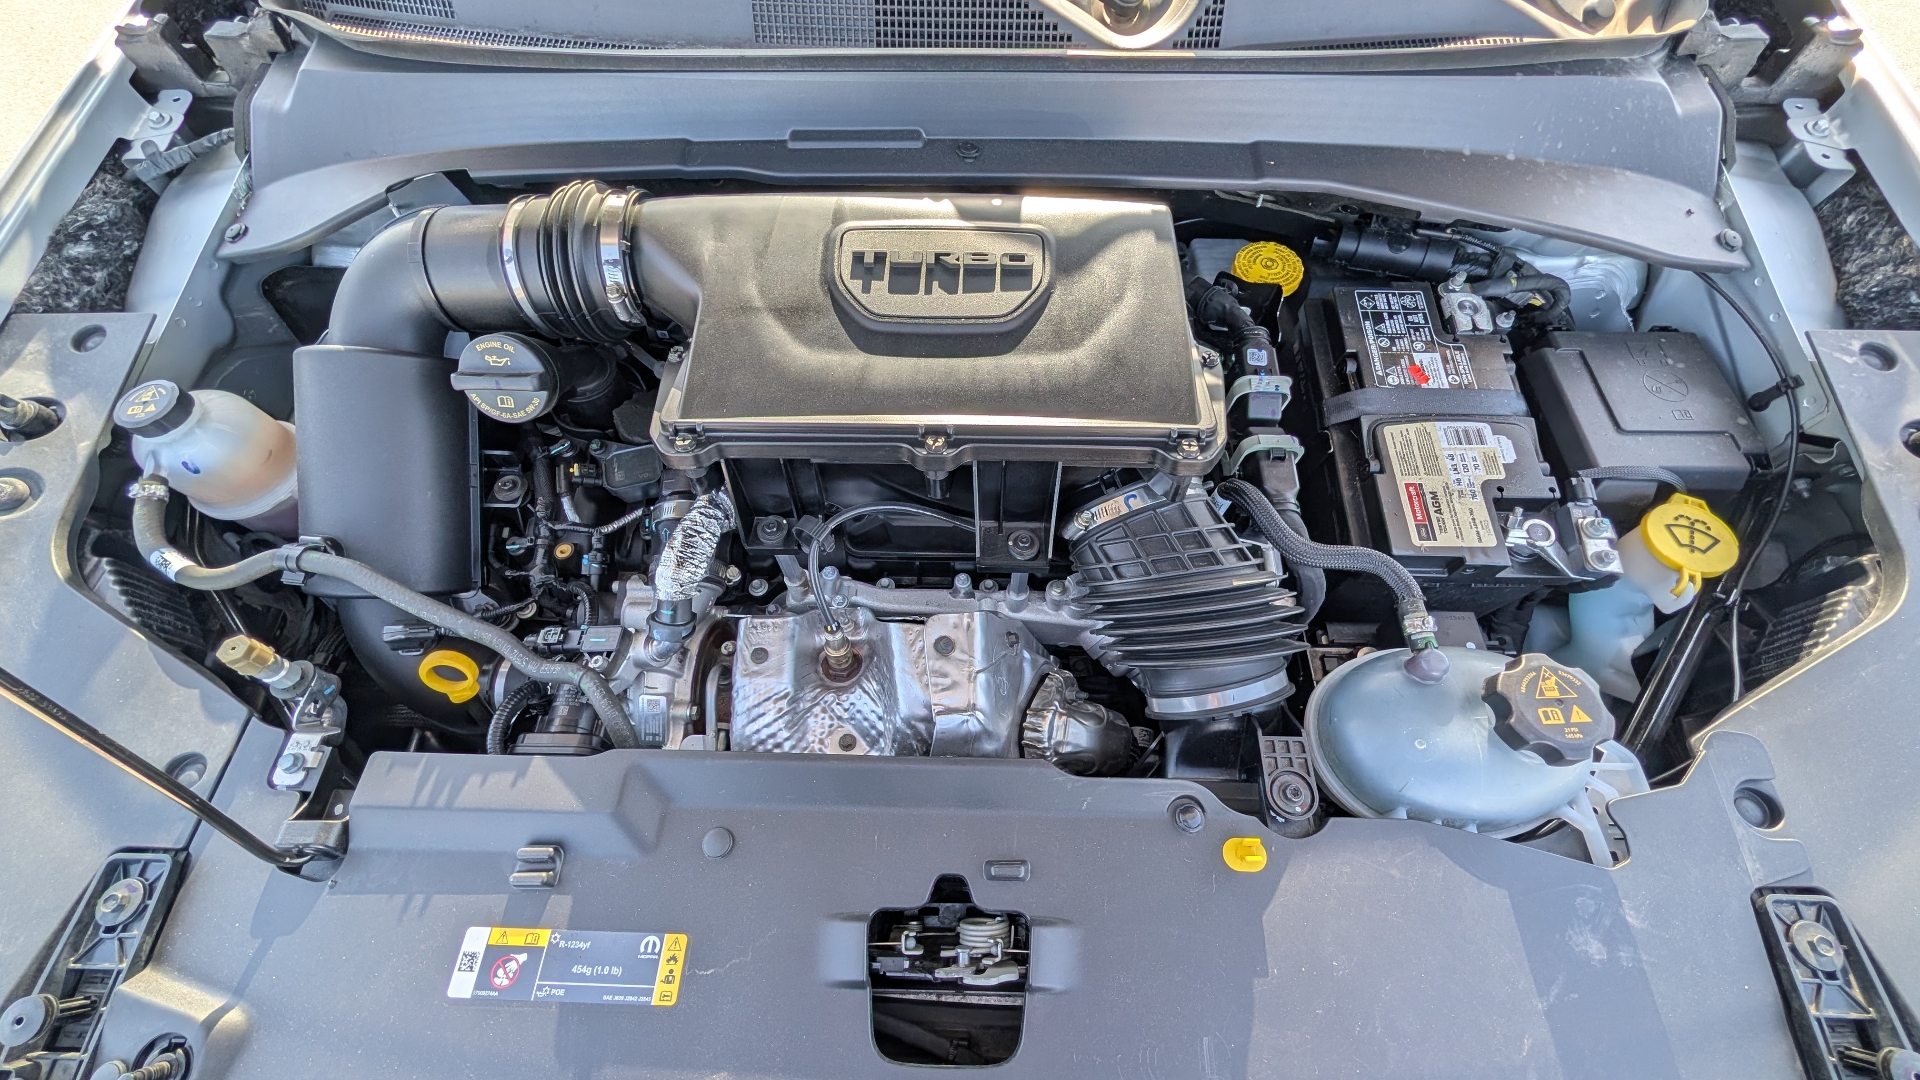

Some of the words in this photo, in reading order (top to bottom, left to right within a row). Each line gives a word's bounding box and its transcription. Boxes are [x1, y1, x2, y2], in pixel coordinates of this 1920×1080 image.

[476, 342, 502, 351] ENGINE
[504, 344, 515, 353] OIL
[470, 393, 481, 405] API
[1409, 486, 1424, 520] Motorcraft
[1429, 491, 1444, 516] AGM
[558, 940, 591, 949] R-1234yf
[572, 966, 592, 976] 454g
[594, 966, 609, 976] (1.0
[611, 966, 622, 977] lb)
